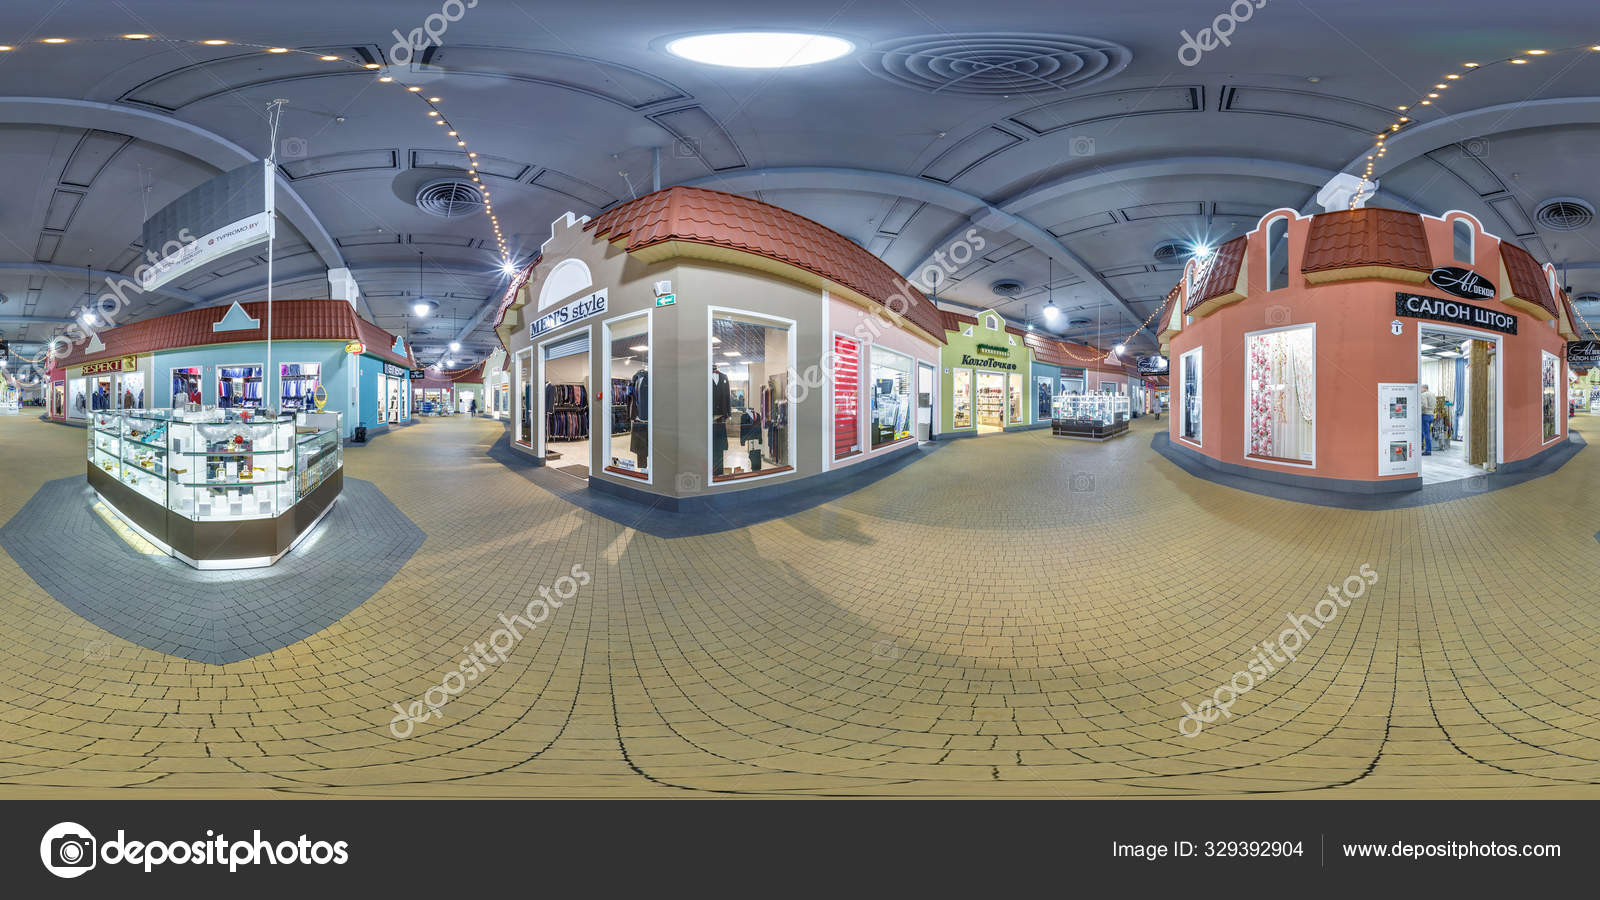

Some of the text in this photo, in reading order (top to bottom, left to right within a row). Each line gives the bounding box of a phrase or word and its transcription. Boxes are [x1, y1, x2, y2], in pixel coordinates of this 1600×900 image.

[530, 294, 605, 336] MEN'S style
[1406, 297, 1513, 328] САЛОН ШТОР
